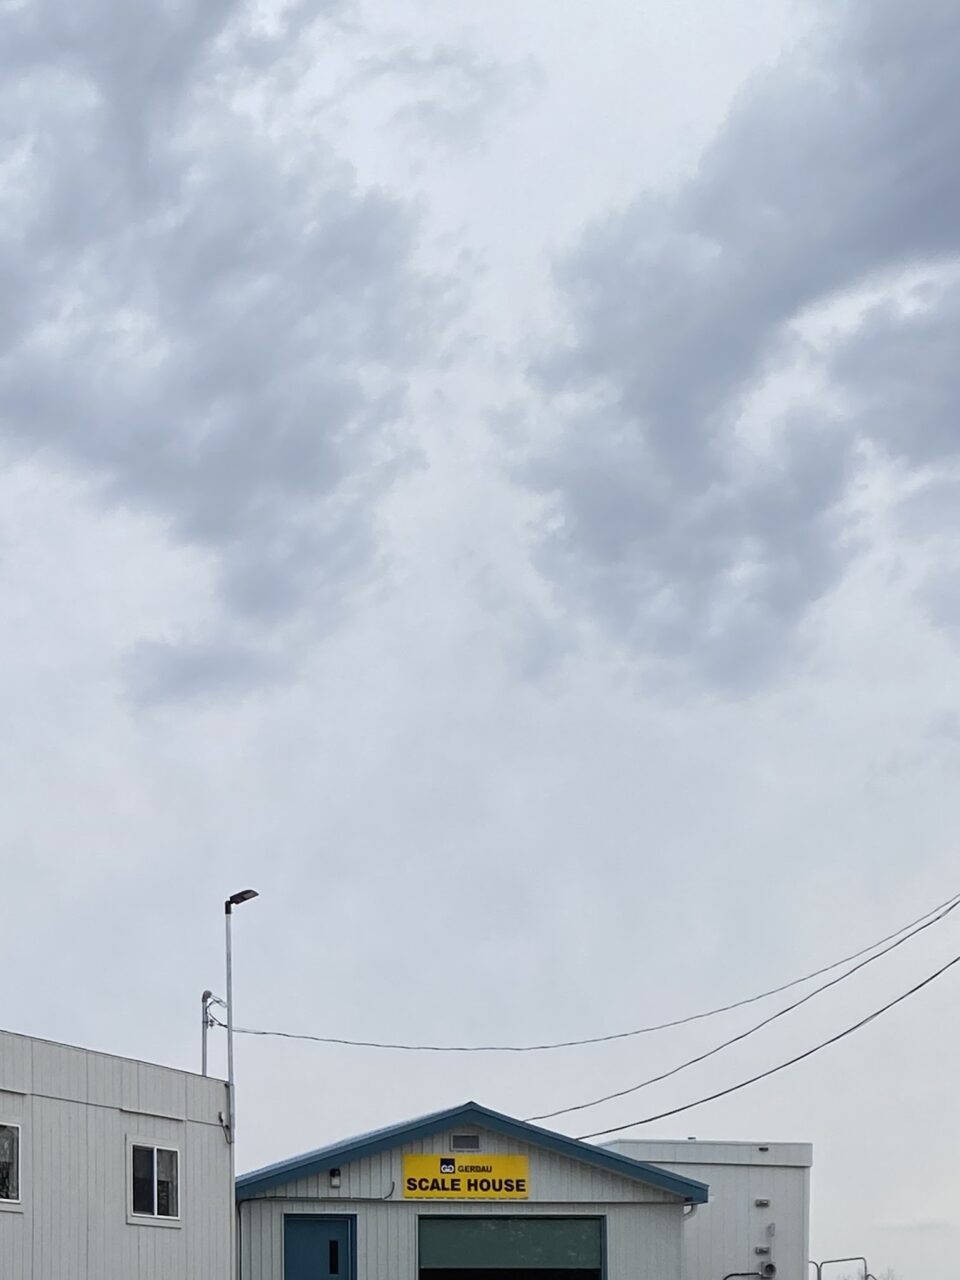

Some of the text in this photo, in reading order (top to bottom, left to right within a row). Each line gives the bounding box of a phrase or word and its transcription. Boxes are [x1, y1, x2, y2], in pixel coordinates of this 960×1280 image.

[457, 1165, 492, 1173] GERDAU
[406, 1178, 526, 1192] SCALE HOUSE
